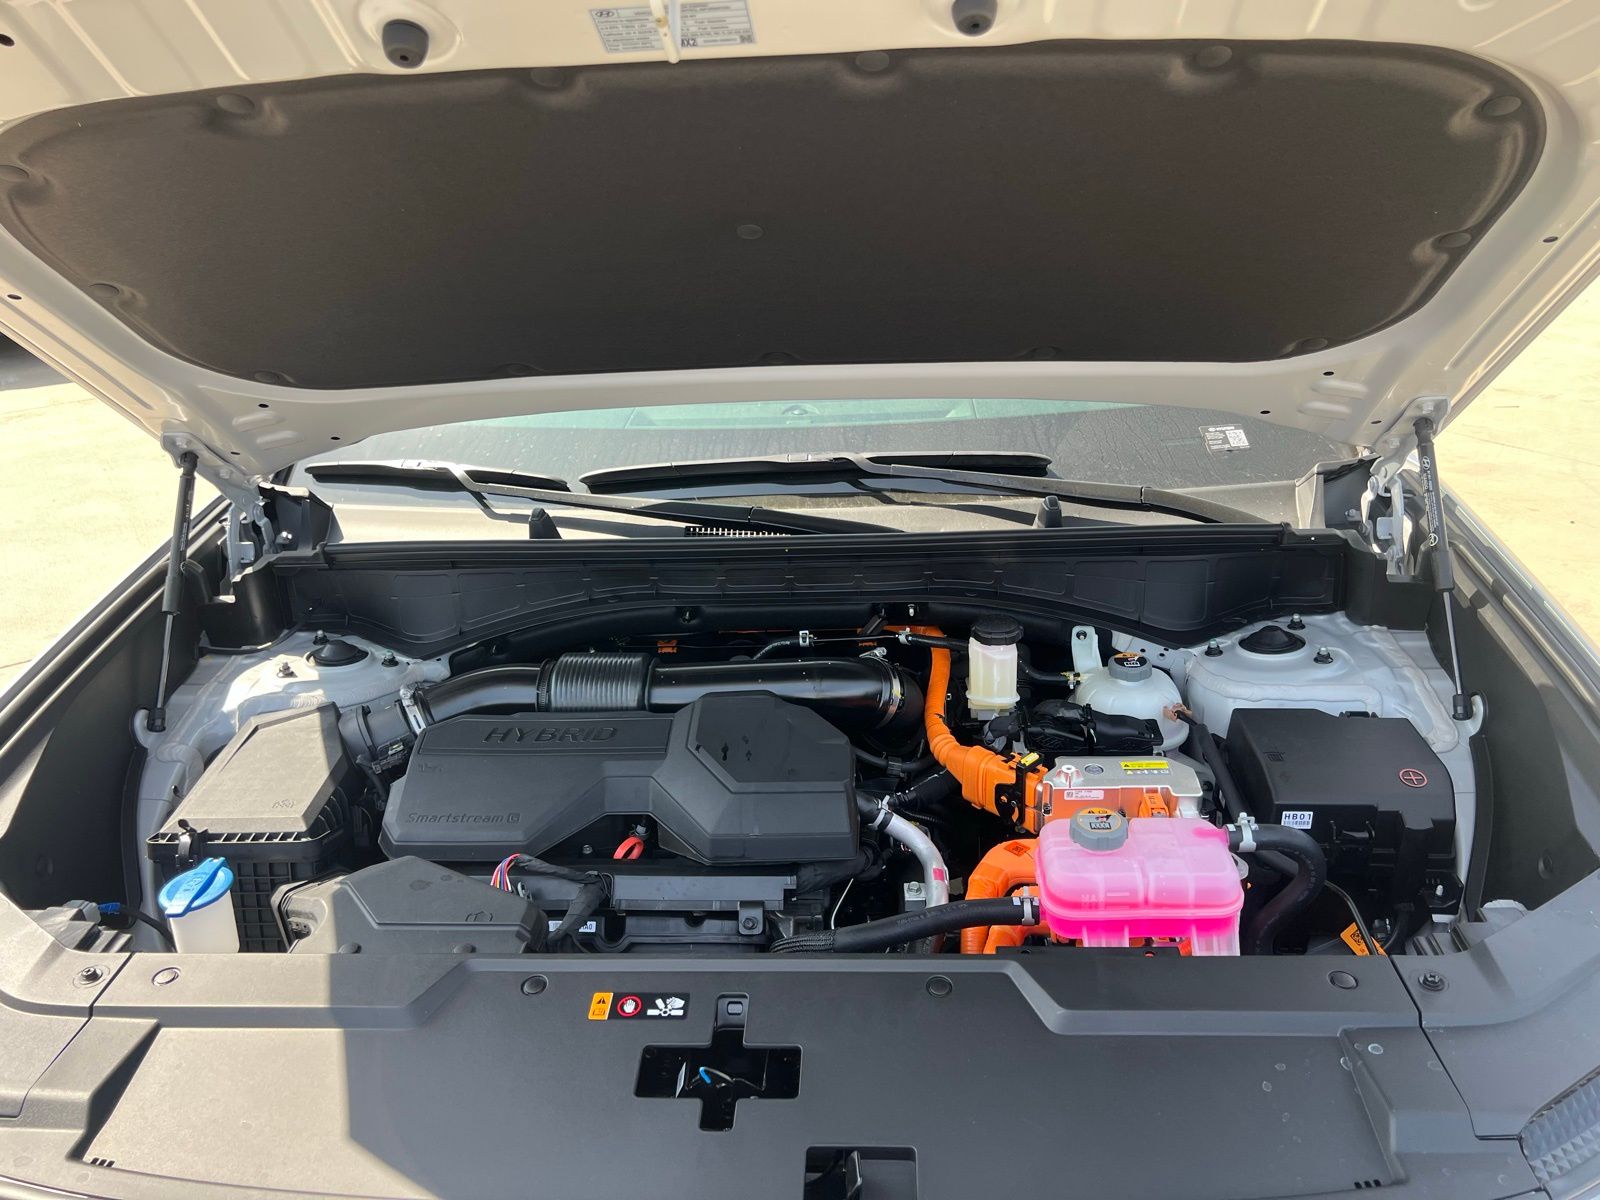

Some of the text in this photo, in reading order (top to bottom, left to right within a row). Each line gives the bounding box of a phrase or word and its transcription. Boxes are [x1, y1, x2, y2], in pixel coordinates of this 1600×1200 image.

[482, 727, 618, 743] HYBRID
[407, 812, 503, 824] Smartstream
[1284, 813, 1312, 821] HB01
